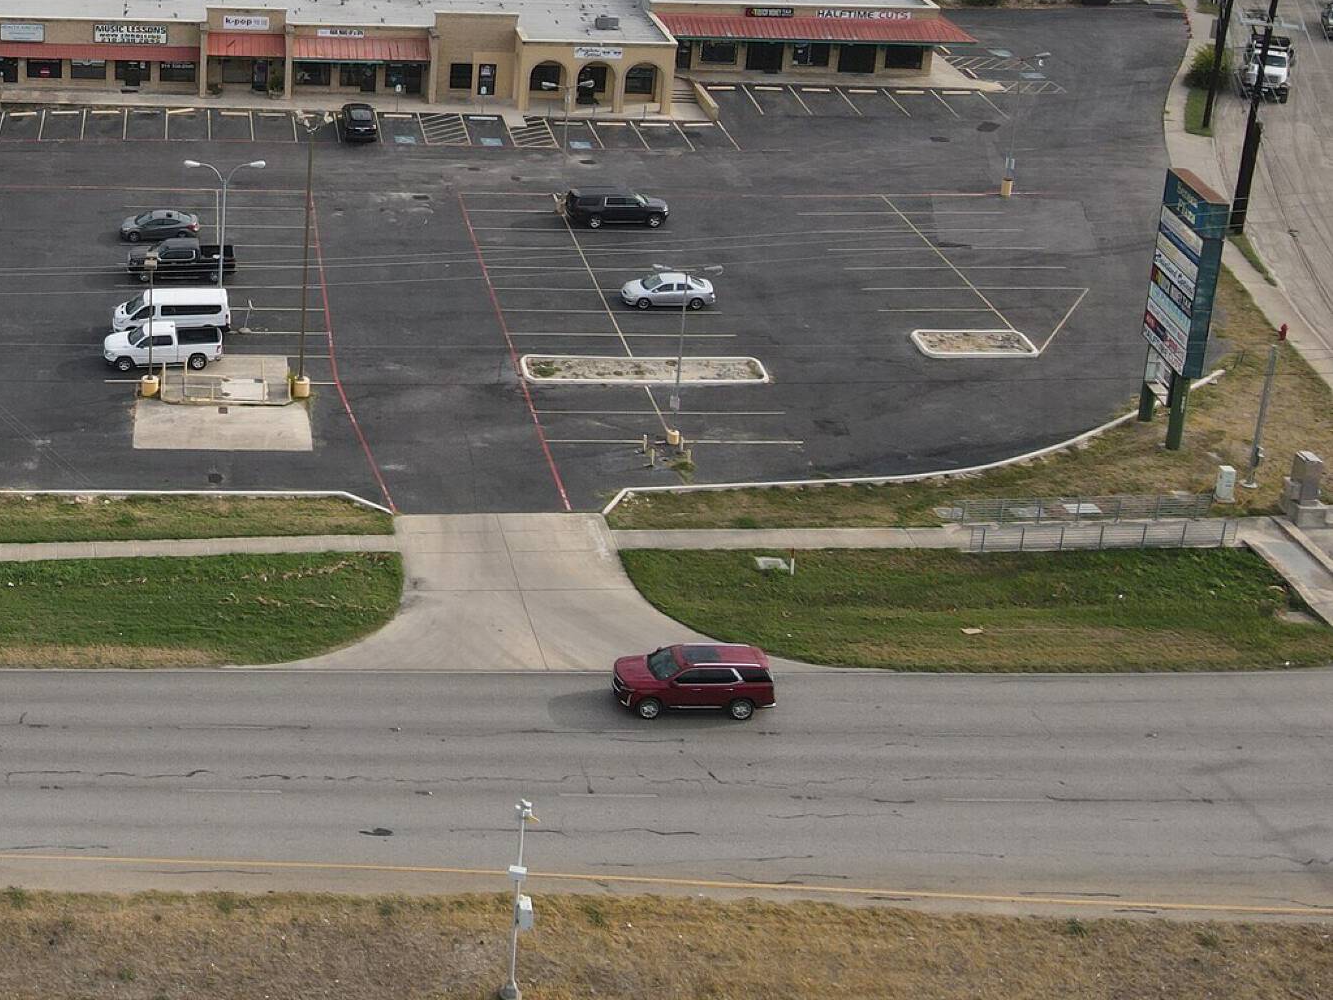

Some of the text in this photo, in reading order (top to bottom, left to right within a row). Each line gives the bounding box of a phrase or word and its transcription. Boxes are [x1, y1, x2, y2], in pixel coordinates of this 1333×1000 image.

[817, 9, 910, 19] HALFTIME CUTS
[95, 24, 166, 35] MUSIC LESSONS
